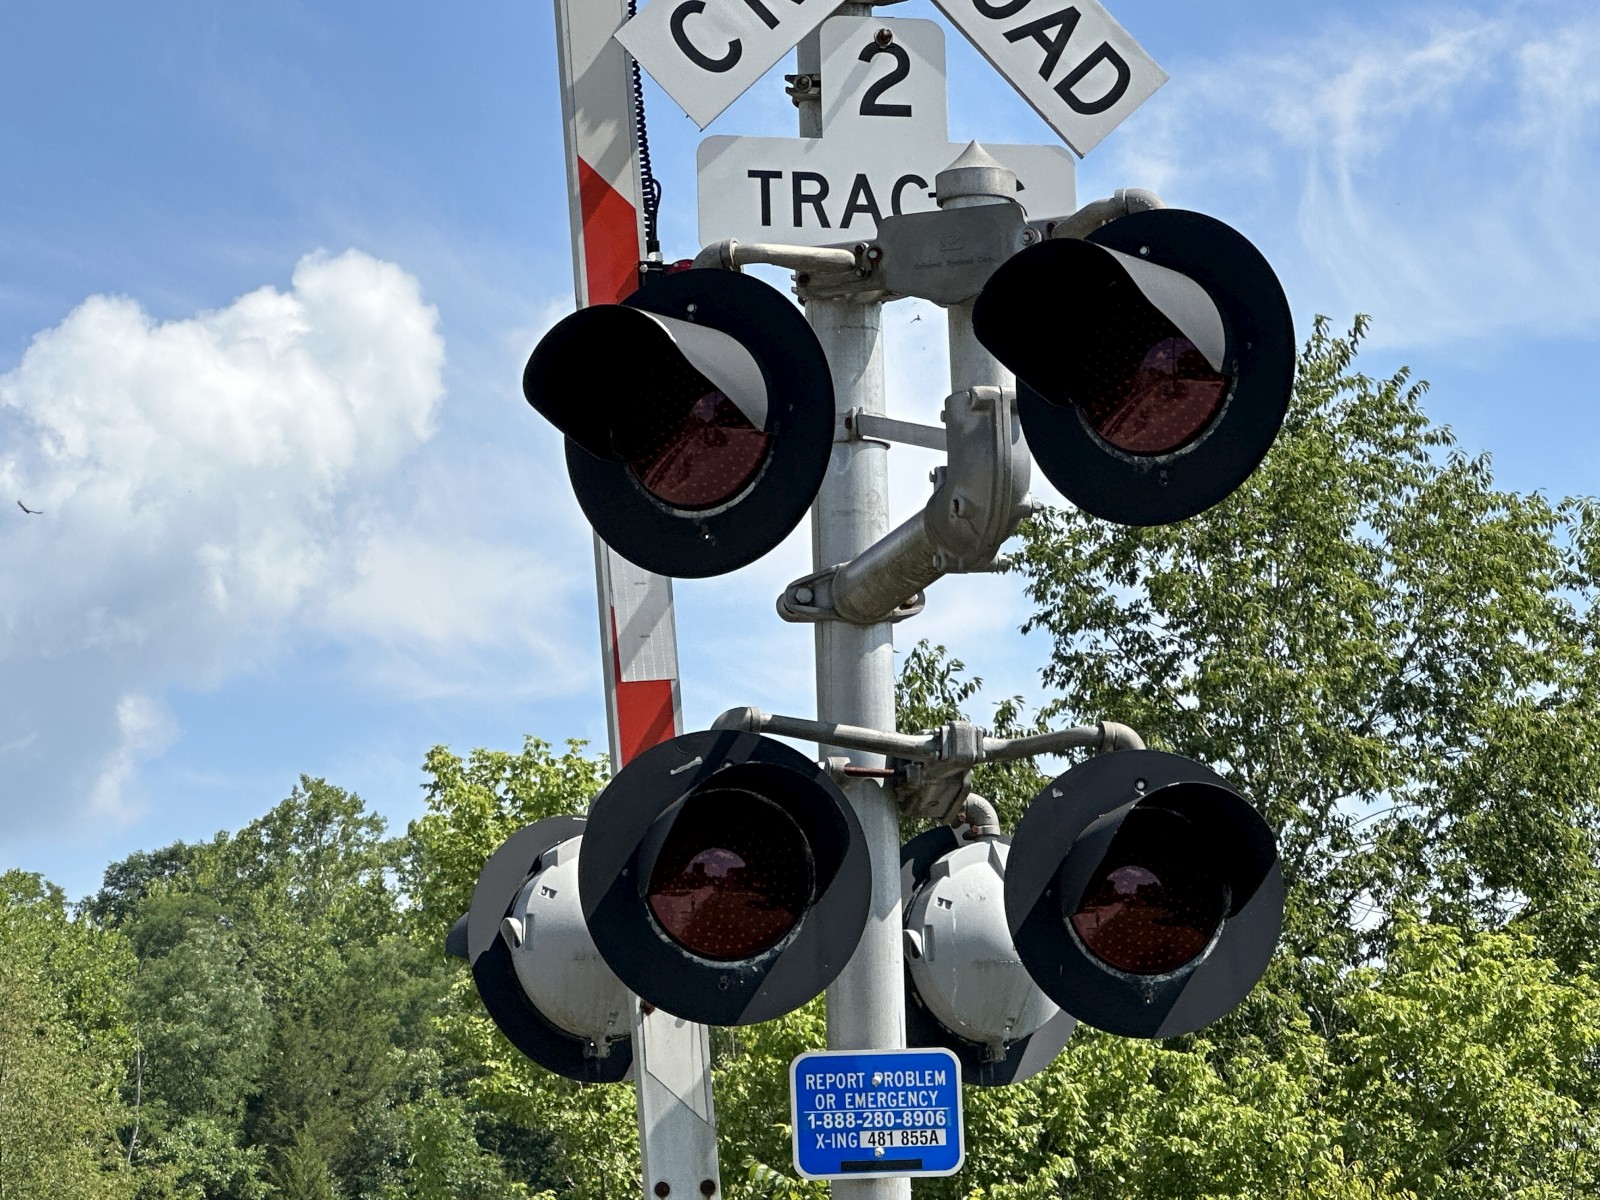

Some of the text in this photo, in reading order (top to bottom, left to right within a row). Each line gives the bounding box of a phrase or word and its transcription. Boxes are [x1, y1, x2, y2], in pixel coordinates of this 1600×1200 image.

[971, 0, 1131, 115] AD
[858, 40, 912, 118] 2
[747, 169, 1026, 230] TRAC
[805, 1072, 865, 1090] REPORT
[815, 1090, 938, 1110] OR EMERGENCY
[807, 1111, 946, 1129] 1-888-280-8906
[815, 1130, 940, 1149] X-ING 481 855A
